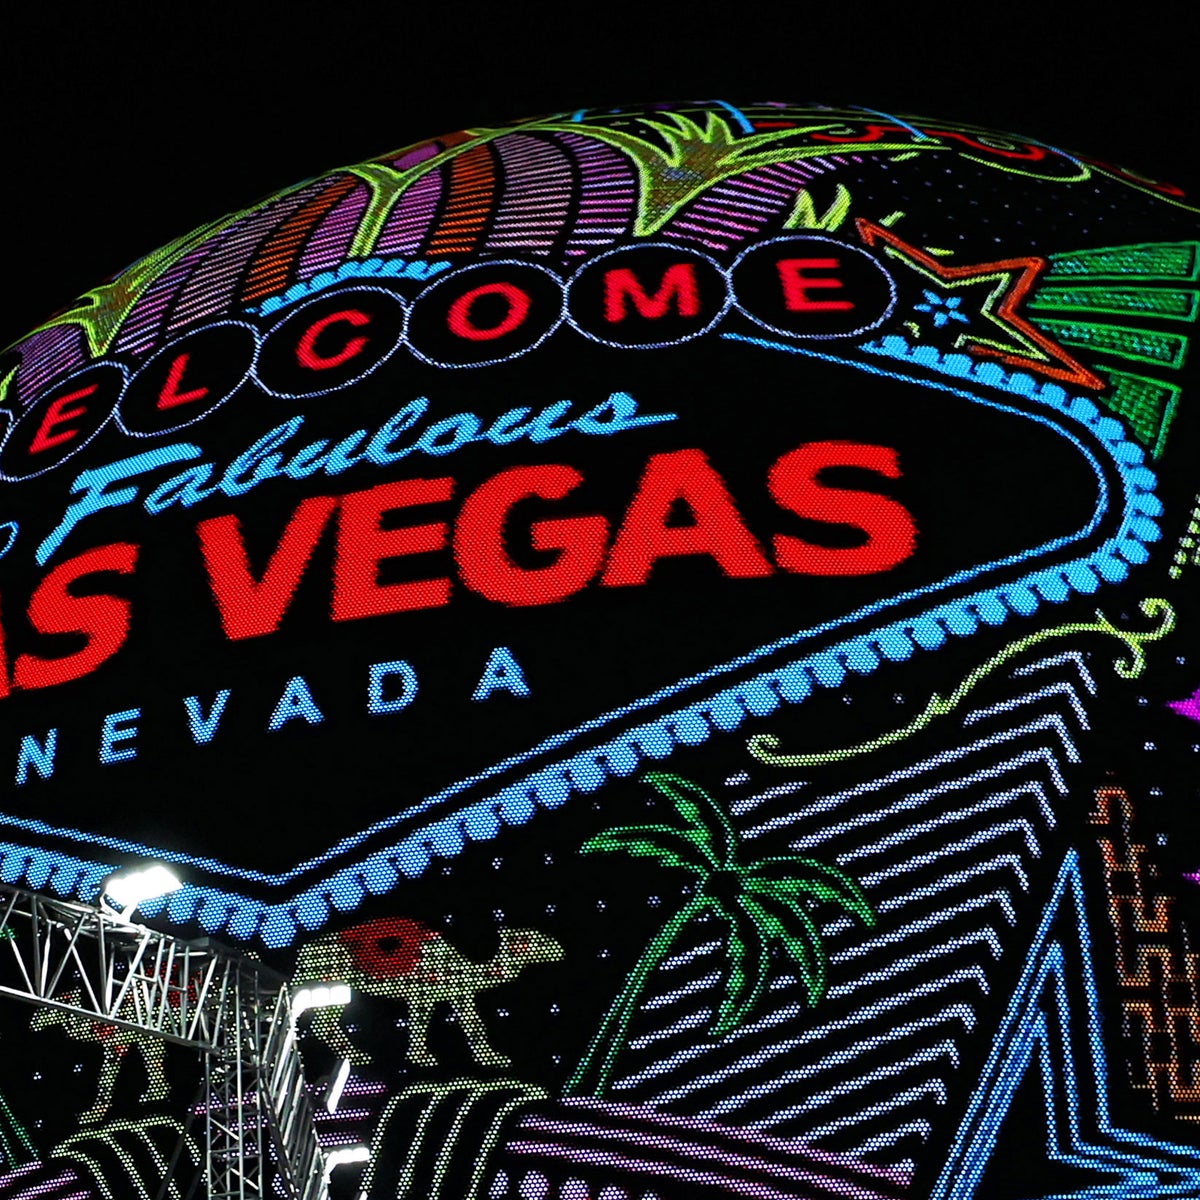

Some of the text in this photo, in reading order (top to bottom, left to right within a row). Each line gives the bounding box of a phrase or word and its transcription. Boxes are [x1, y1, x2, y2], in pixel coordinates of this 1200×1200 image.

[35, 392, 678, 566] Fabulous
[197, 441, 919, 641] VEGAS
[15, 646, 532, 786] NEVADA
